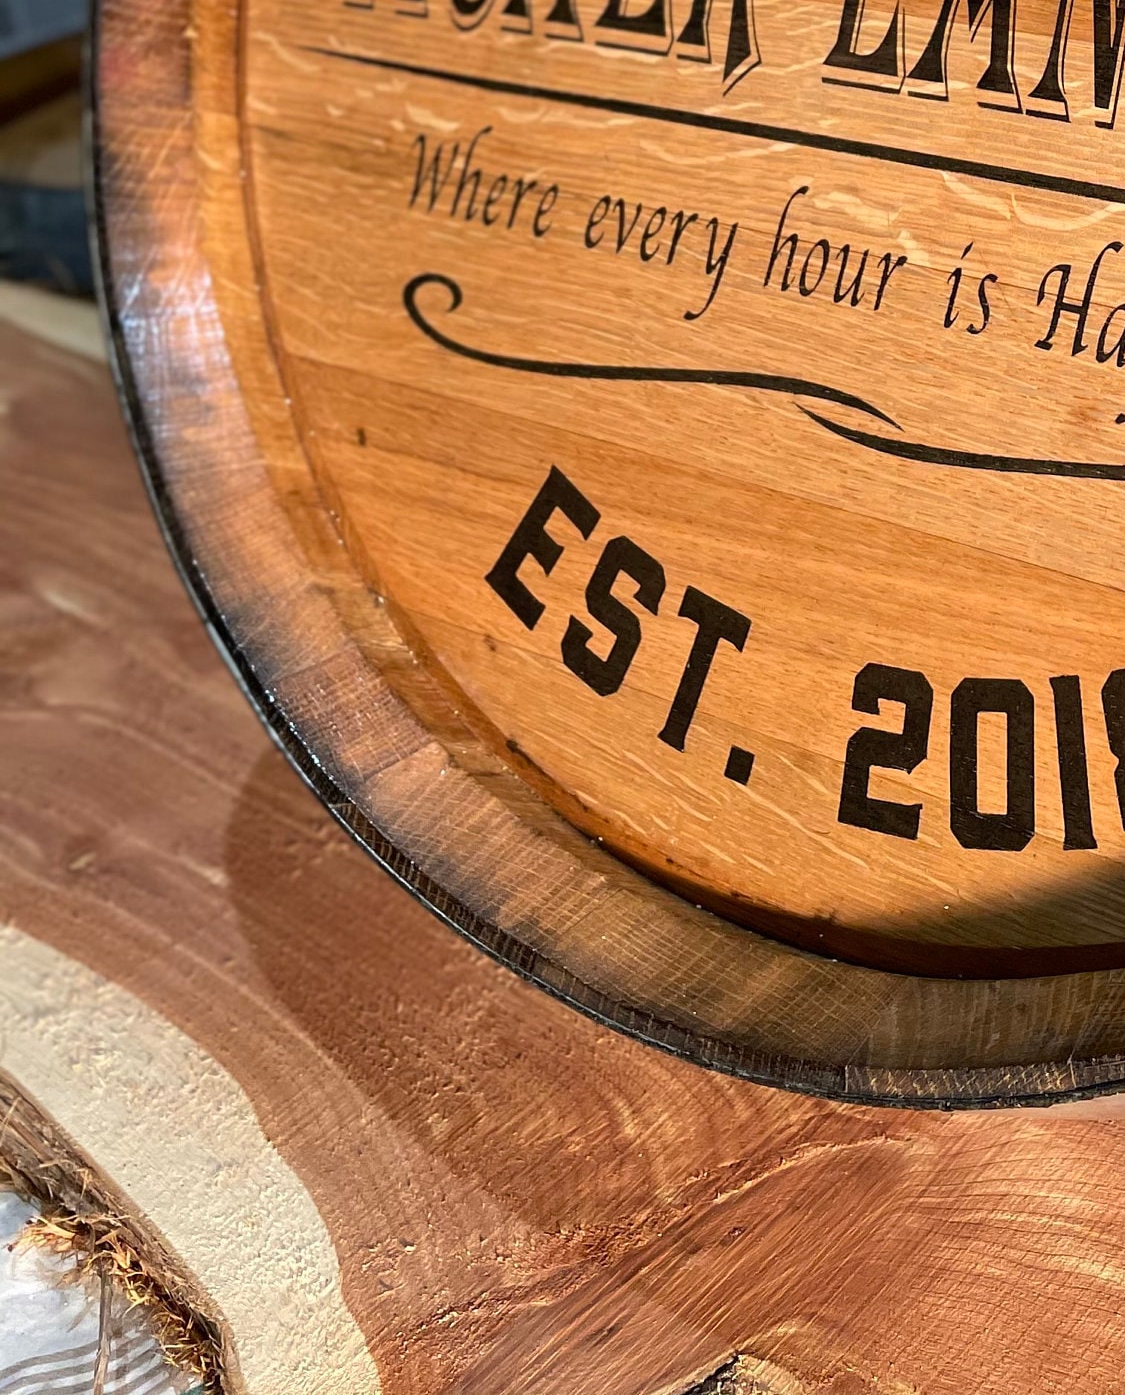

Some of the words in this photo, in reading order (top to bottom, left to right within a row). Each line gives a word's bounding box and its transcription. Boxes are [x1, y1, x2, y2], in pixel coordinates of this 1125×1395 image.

[408, 126, 560, 239] Where
[584, 192, 737, 320] every
[764, 185, 908, 311] hour
[944, 240, 997, 336] is
[486, 466, 754, 784] EST.
